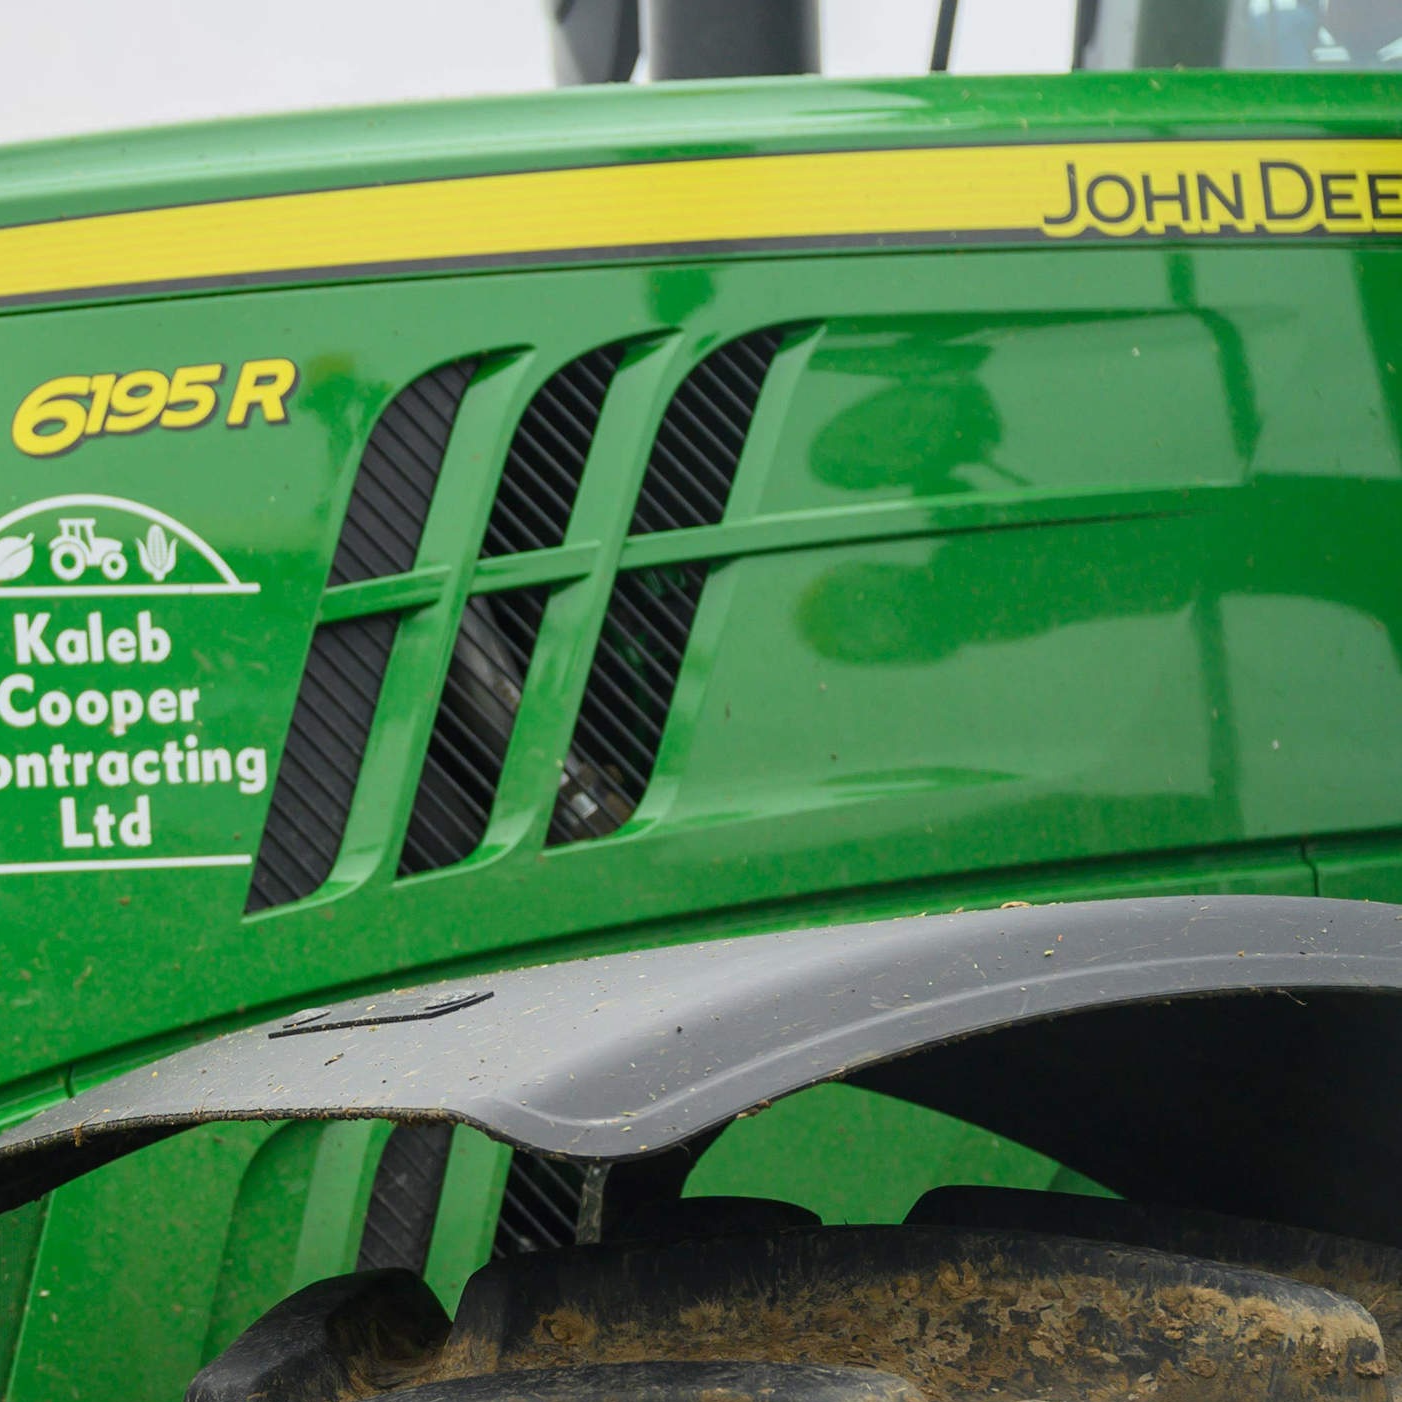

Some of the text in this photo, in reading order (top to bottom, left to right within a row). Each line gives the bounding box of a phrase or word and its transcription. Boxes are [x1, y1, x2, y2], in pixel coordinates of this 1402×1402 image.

[1043, 162, 1245, 226] JOHN
[11, 357, 297, 457] 6195 R
[14, 610, 172, 664] Kaleb
[59, 795, 153, 848] Ltd
